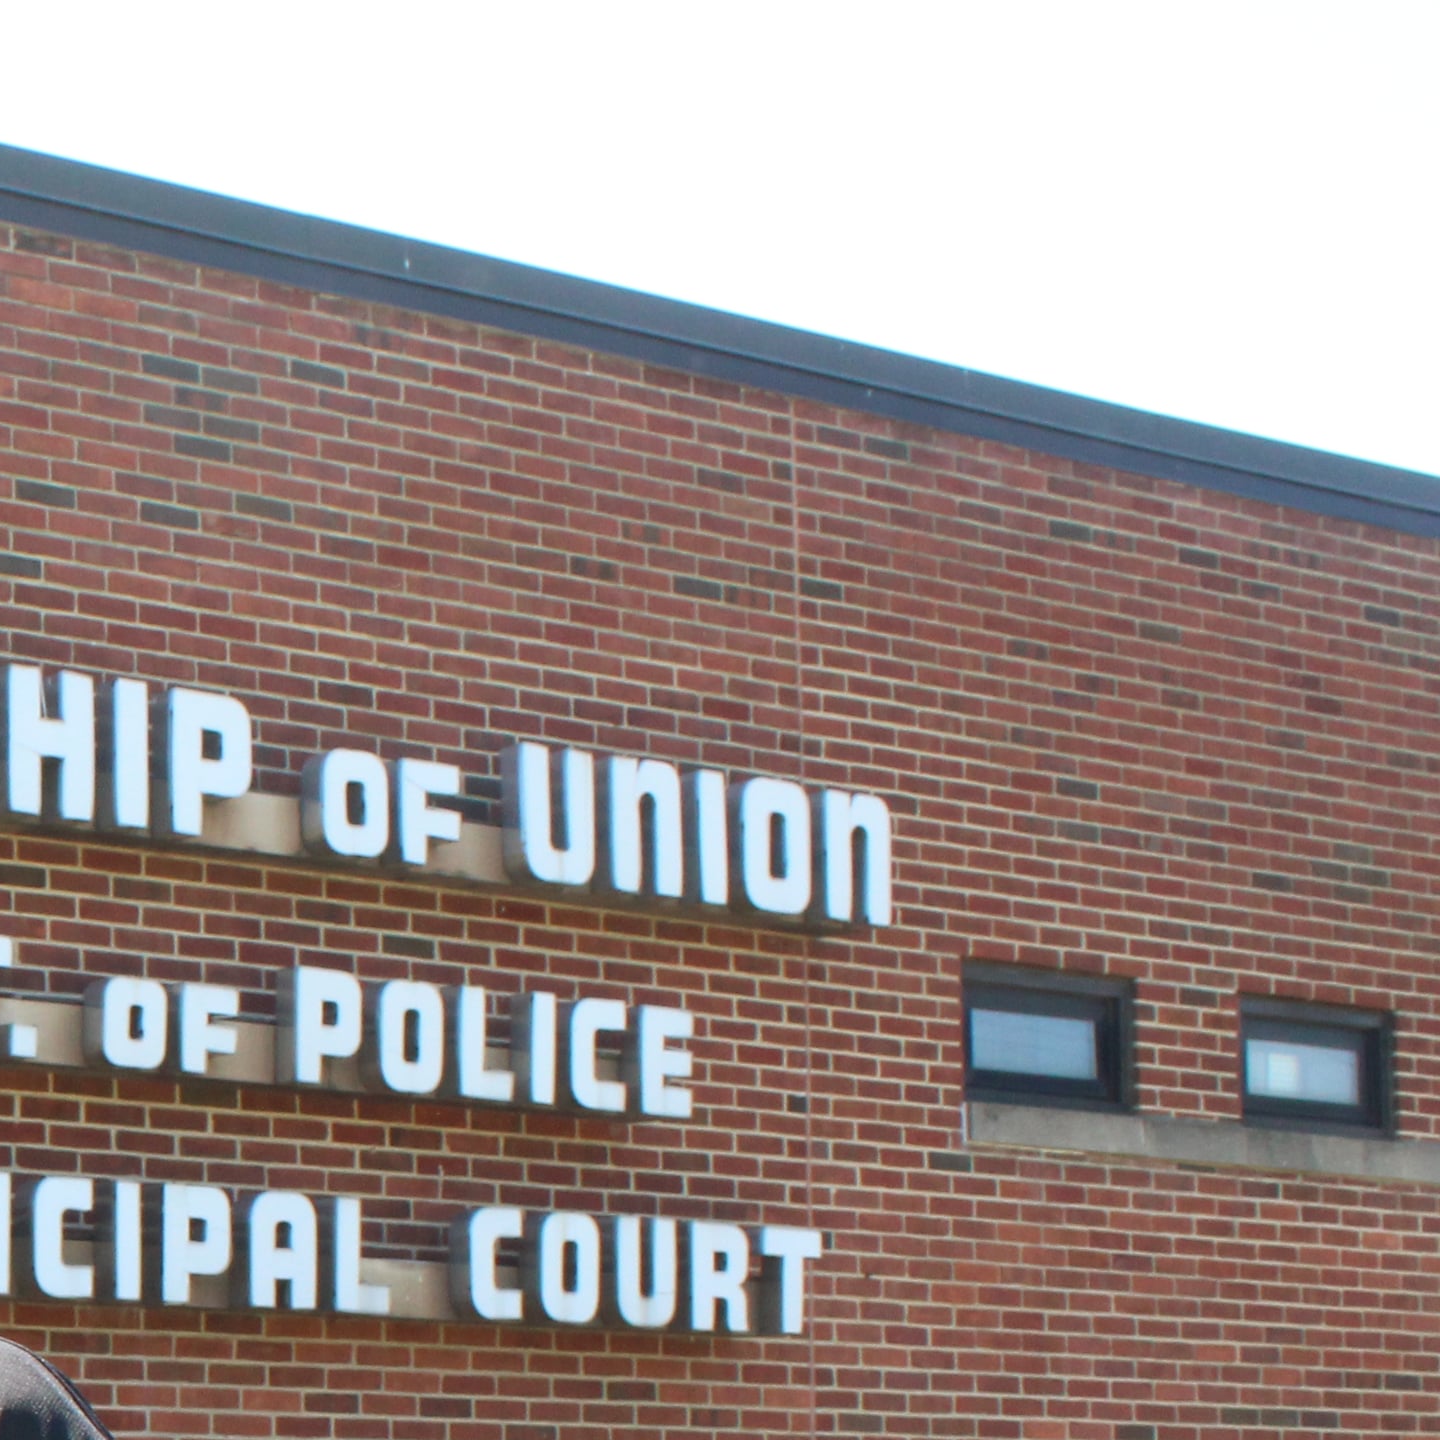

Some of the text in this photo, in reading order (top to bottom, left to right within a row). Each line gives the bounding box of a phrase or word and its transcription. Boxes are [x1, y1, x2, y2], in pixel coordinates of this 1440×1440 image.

[320, 748, 462, 866] OF
[520, 740, 892, 926] UNION
[102, 974, 241, 1075] OF
[294, 964, 695, 1119] POLICE
[467, 1207, 823, 1335] COURT
